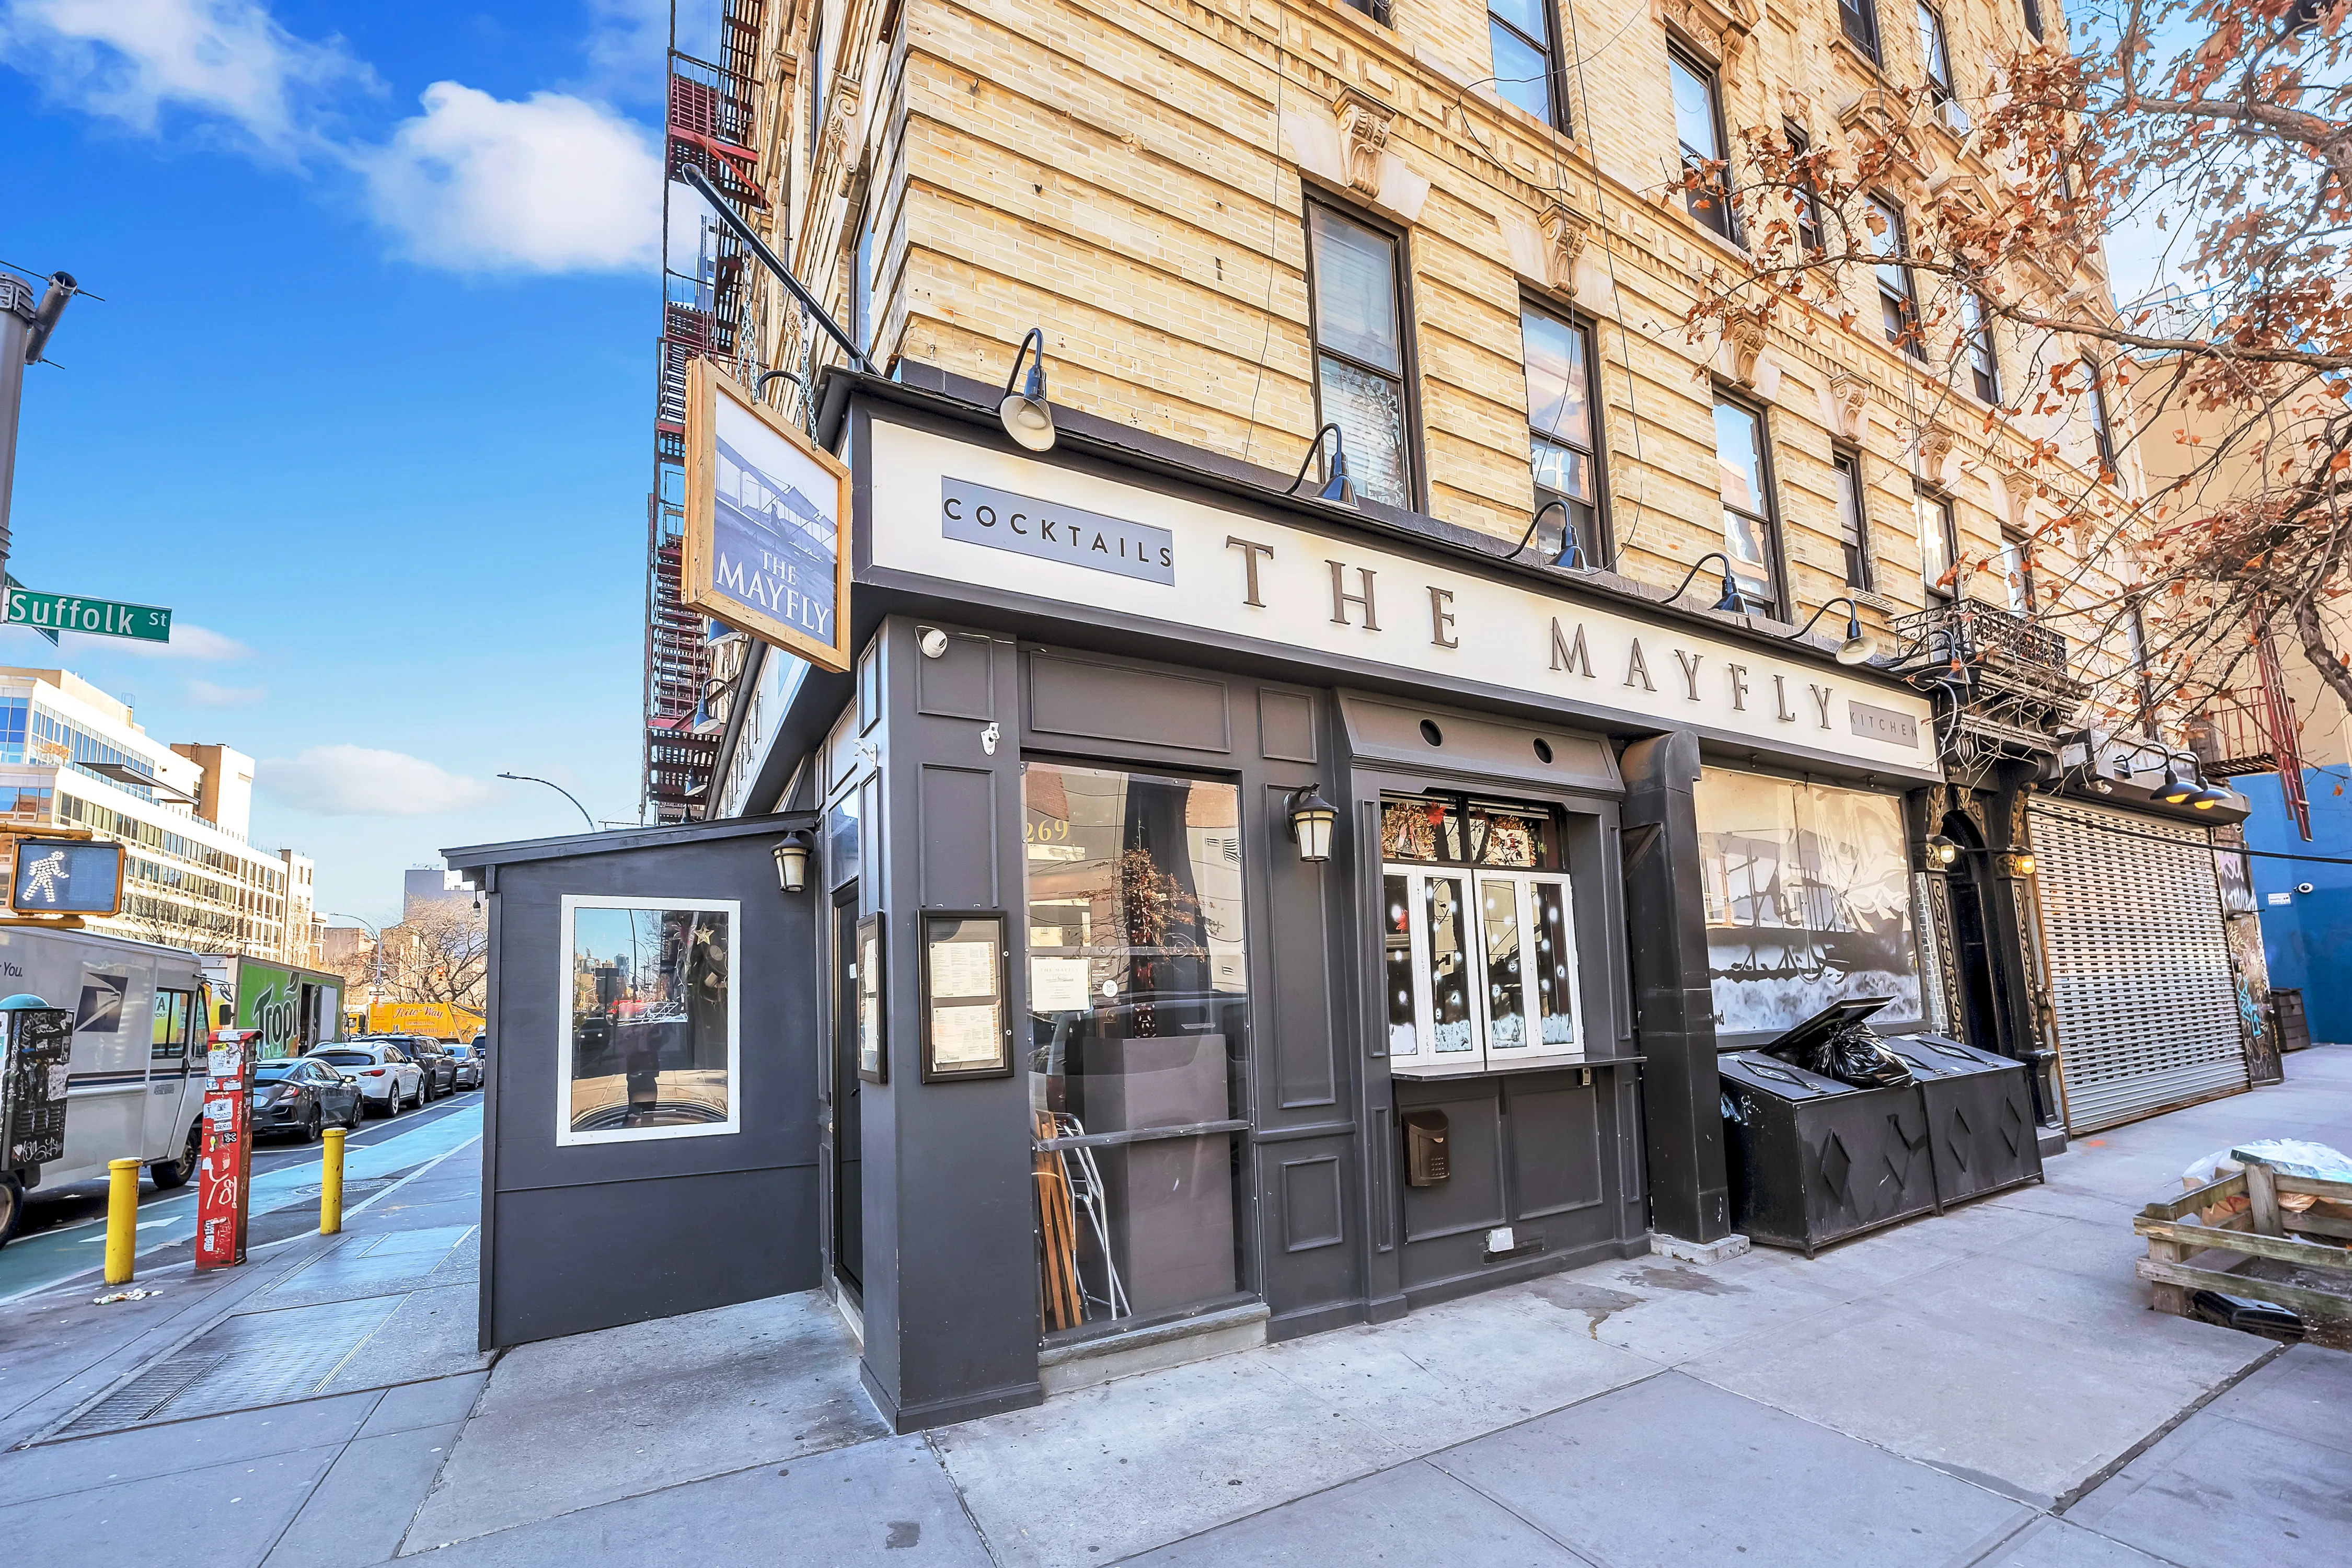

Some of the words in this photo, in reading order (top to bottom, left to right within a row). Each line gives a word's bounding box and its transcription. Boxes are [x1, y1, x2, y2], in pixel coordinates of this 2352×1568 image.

[943, 498, 1171, 568] COCKTAILS
[759, 549, 797, 586] THE
[716, 551, 831, 636] MAYFLY
[9, 594, 134, 635] Suffolk
[148, 612, 167, 627] St
[1226, 535, 1459, 649] THE
[1549, 616, 1833, 730] MAYFLY
[1849, 711, 1917, 738] KITCHEN
[4, 961, 23, 977] You.
[252, 973, 301, 1055] Tropi
[393, 1006, 444, 1020] Rite-Way
